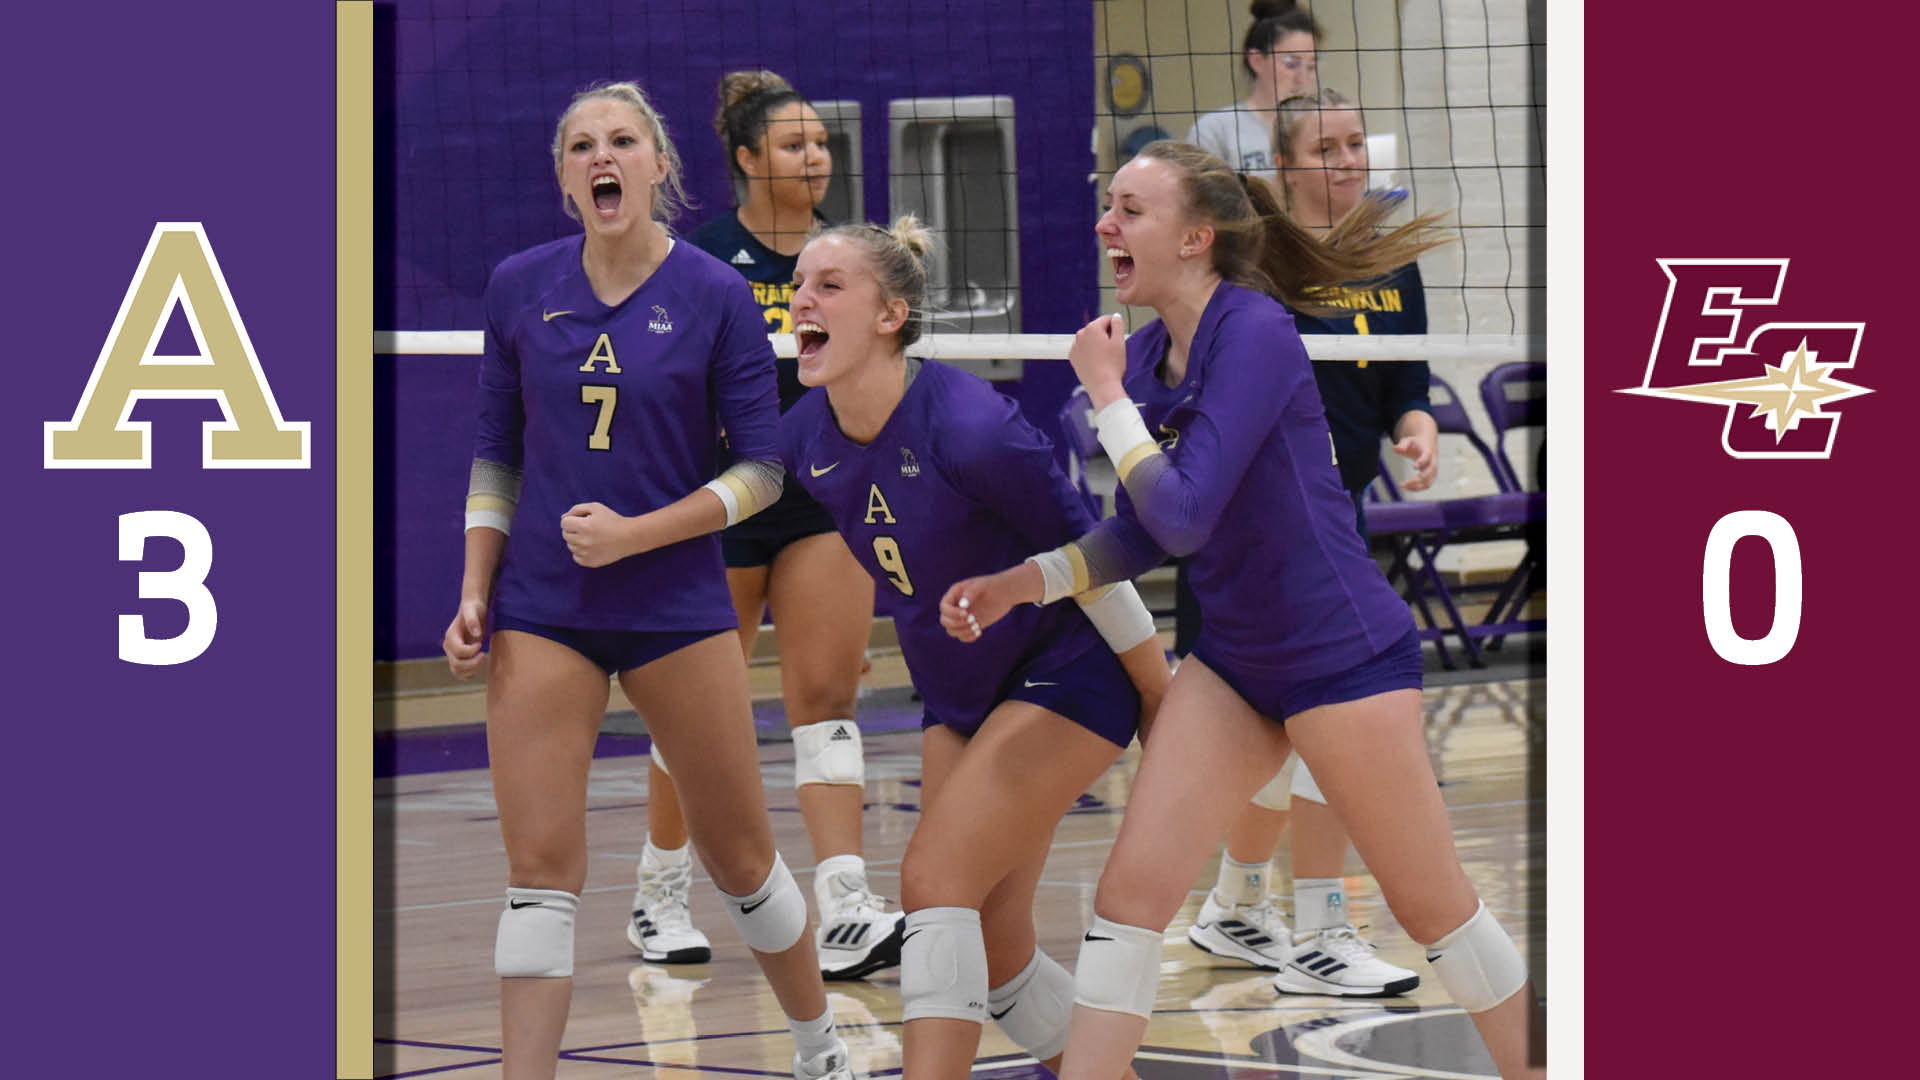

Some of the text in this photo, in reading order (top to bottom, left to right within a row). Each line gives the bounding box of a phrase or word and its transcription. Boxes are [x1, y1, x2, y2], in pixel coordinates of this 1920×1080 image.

[648, 322, 673, 331] MIAA
[579, 332, 622, 374] A
[581, 385, 617, 451] 7
[863, 482, 897, 525] A
[872, 535, 915, 597] 9
